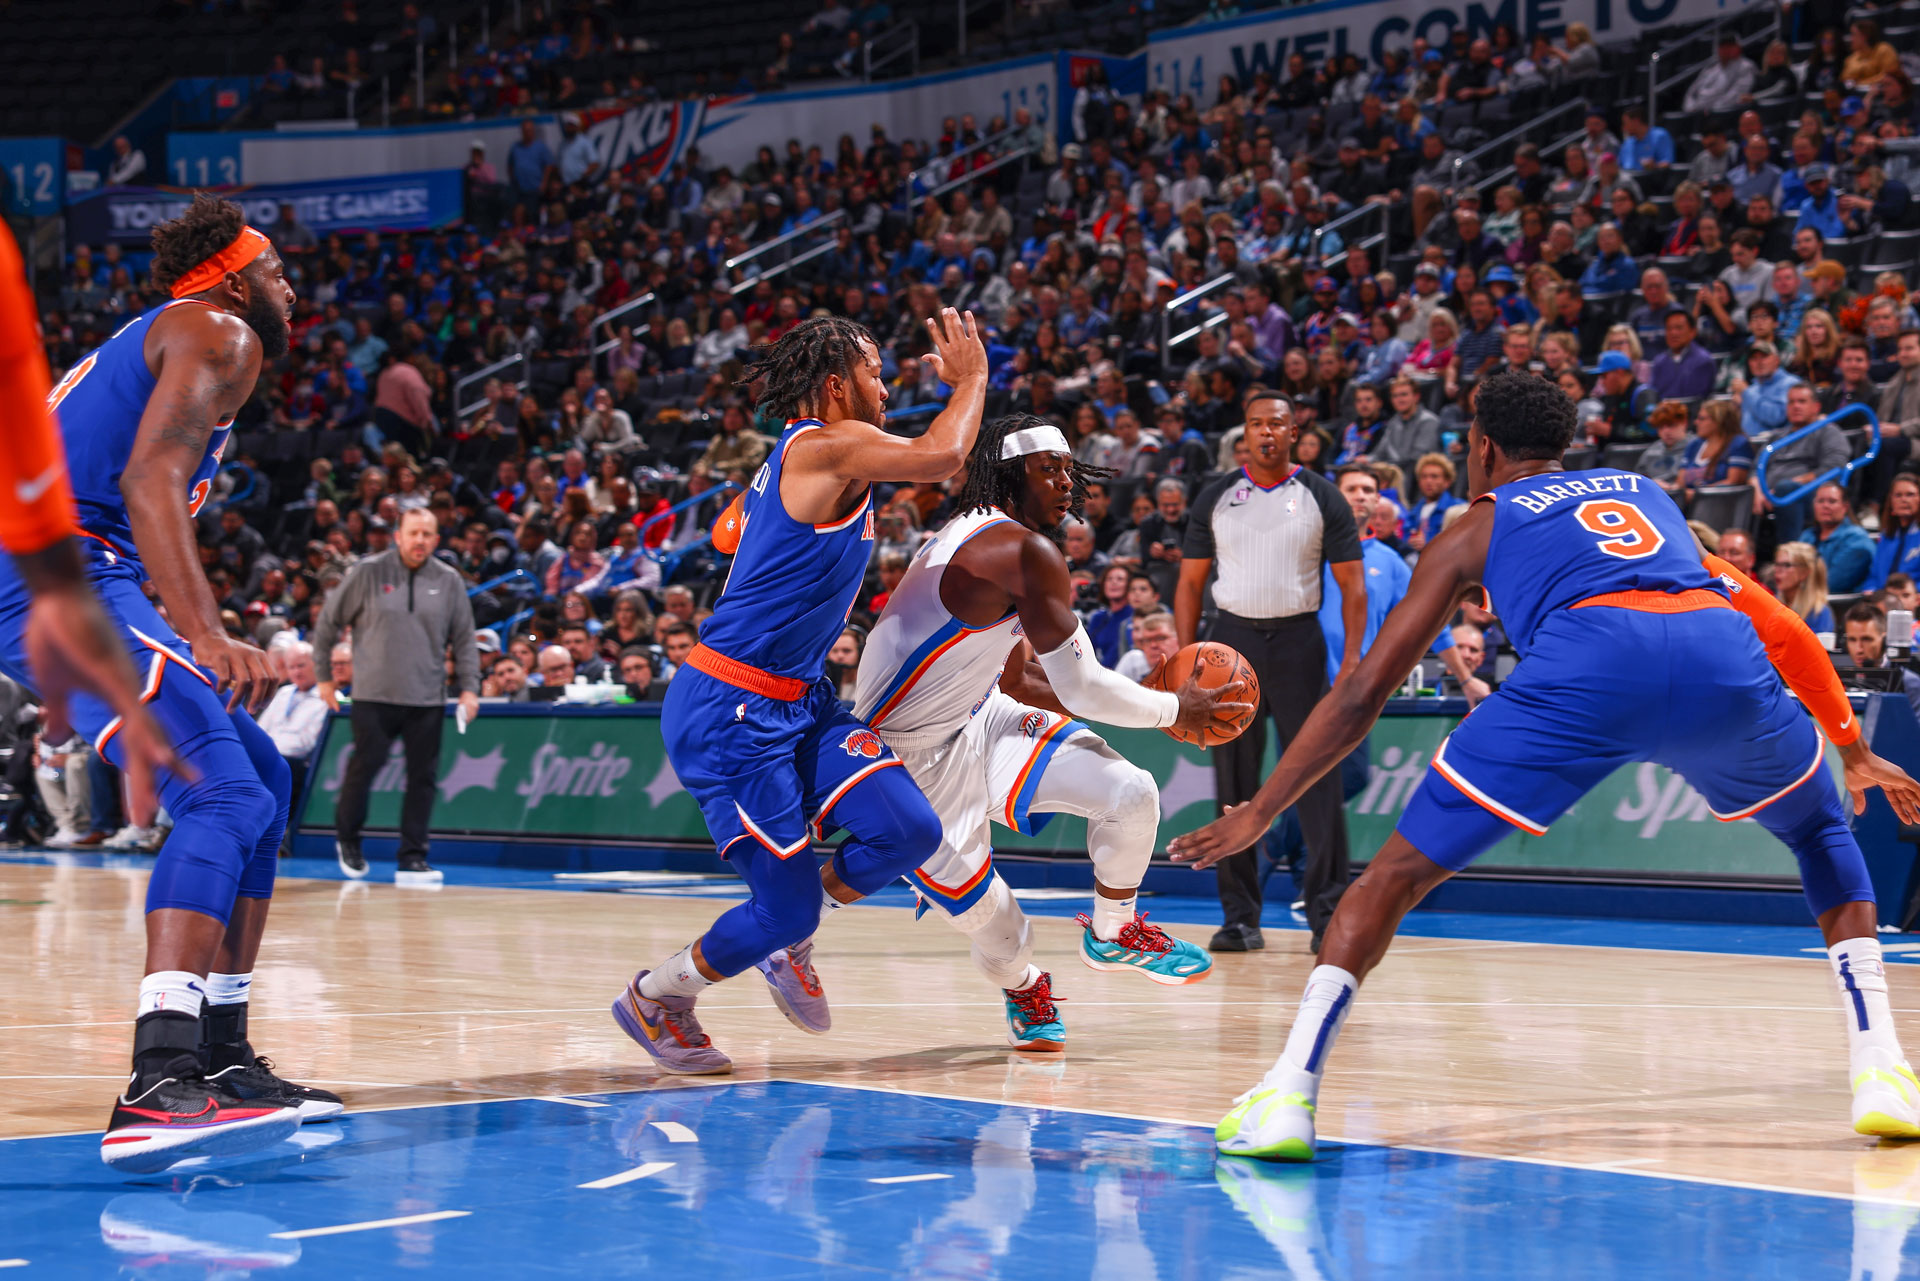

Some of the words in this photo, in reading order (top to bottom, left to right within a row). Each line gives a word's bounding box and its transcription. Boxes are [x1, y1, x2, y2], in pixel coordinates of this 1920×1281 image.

[1231, 0, 1565, 92] WELCOME
[174, 157, 238, 187] 113
[1511, 474, 1643, 514] BARRETT
[1573, 498, 1666, 560] 9
[516, 741, 632, 808] Sprite
